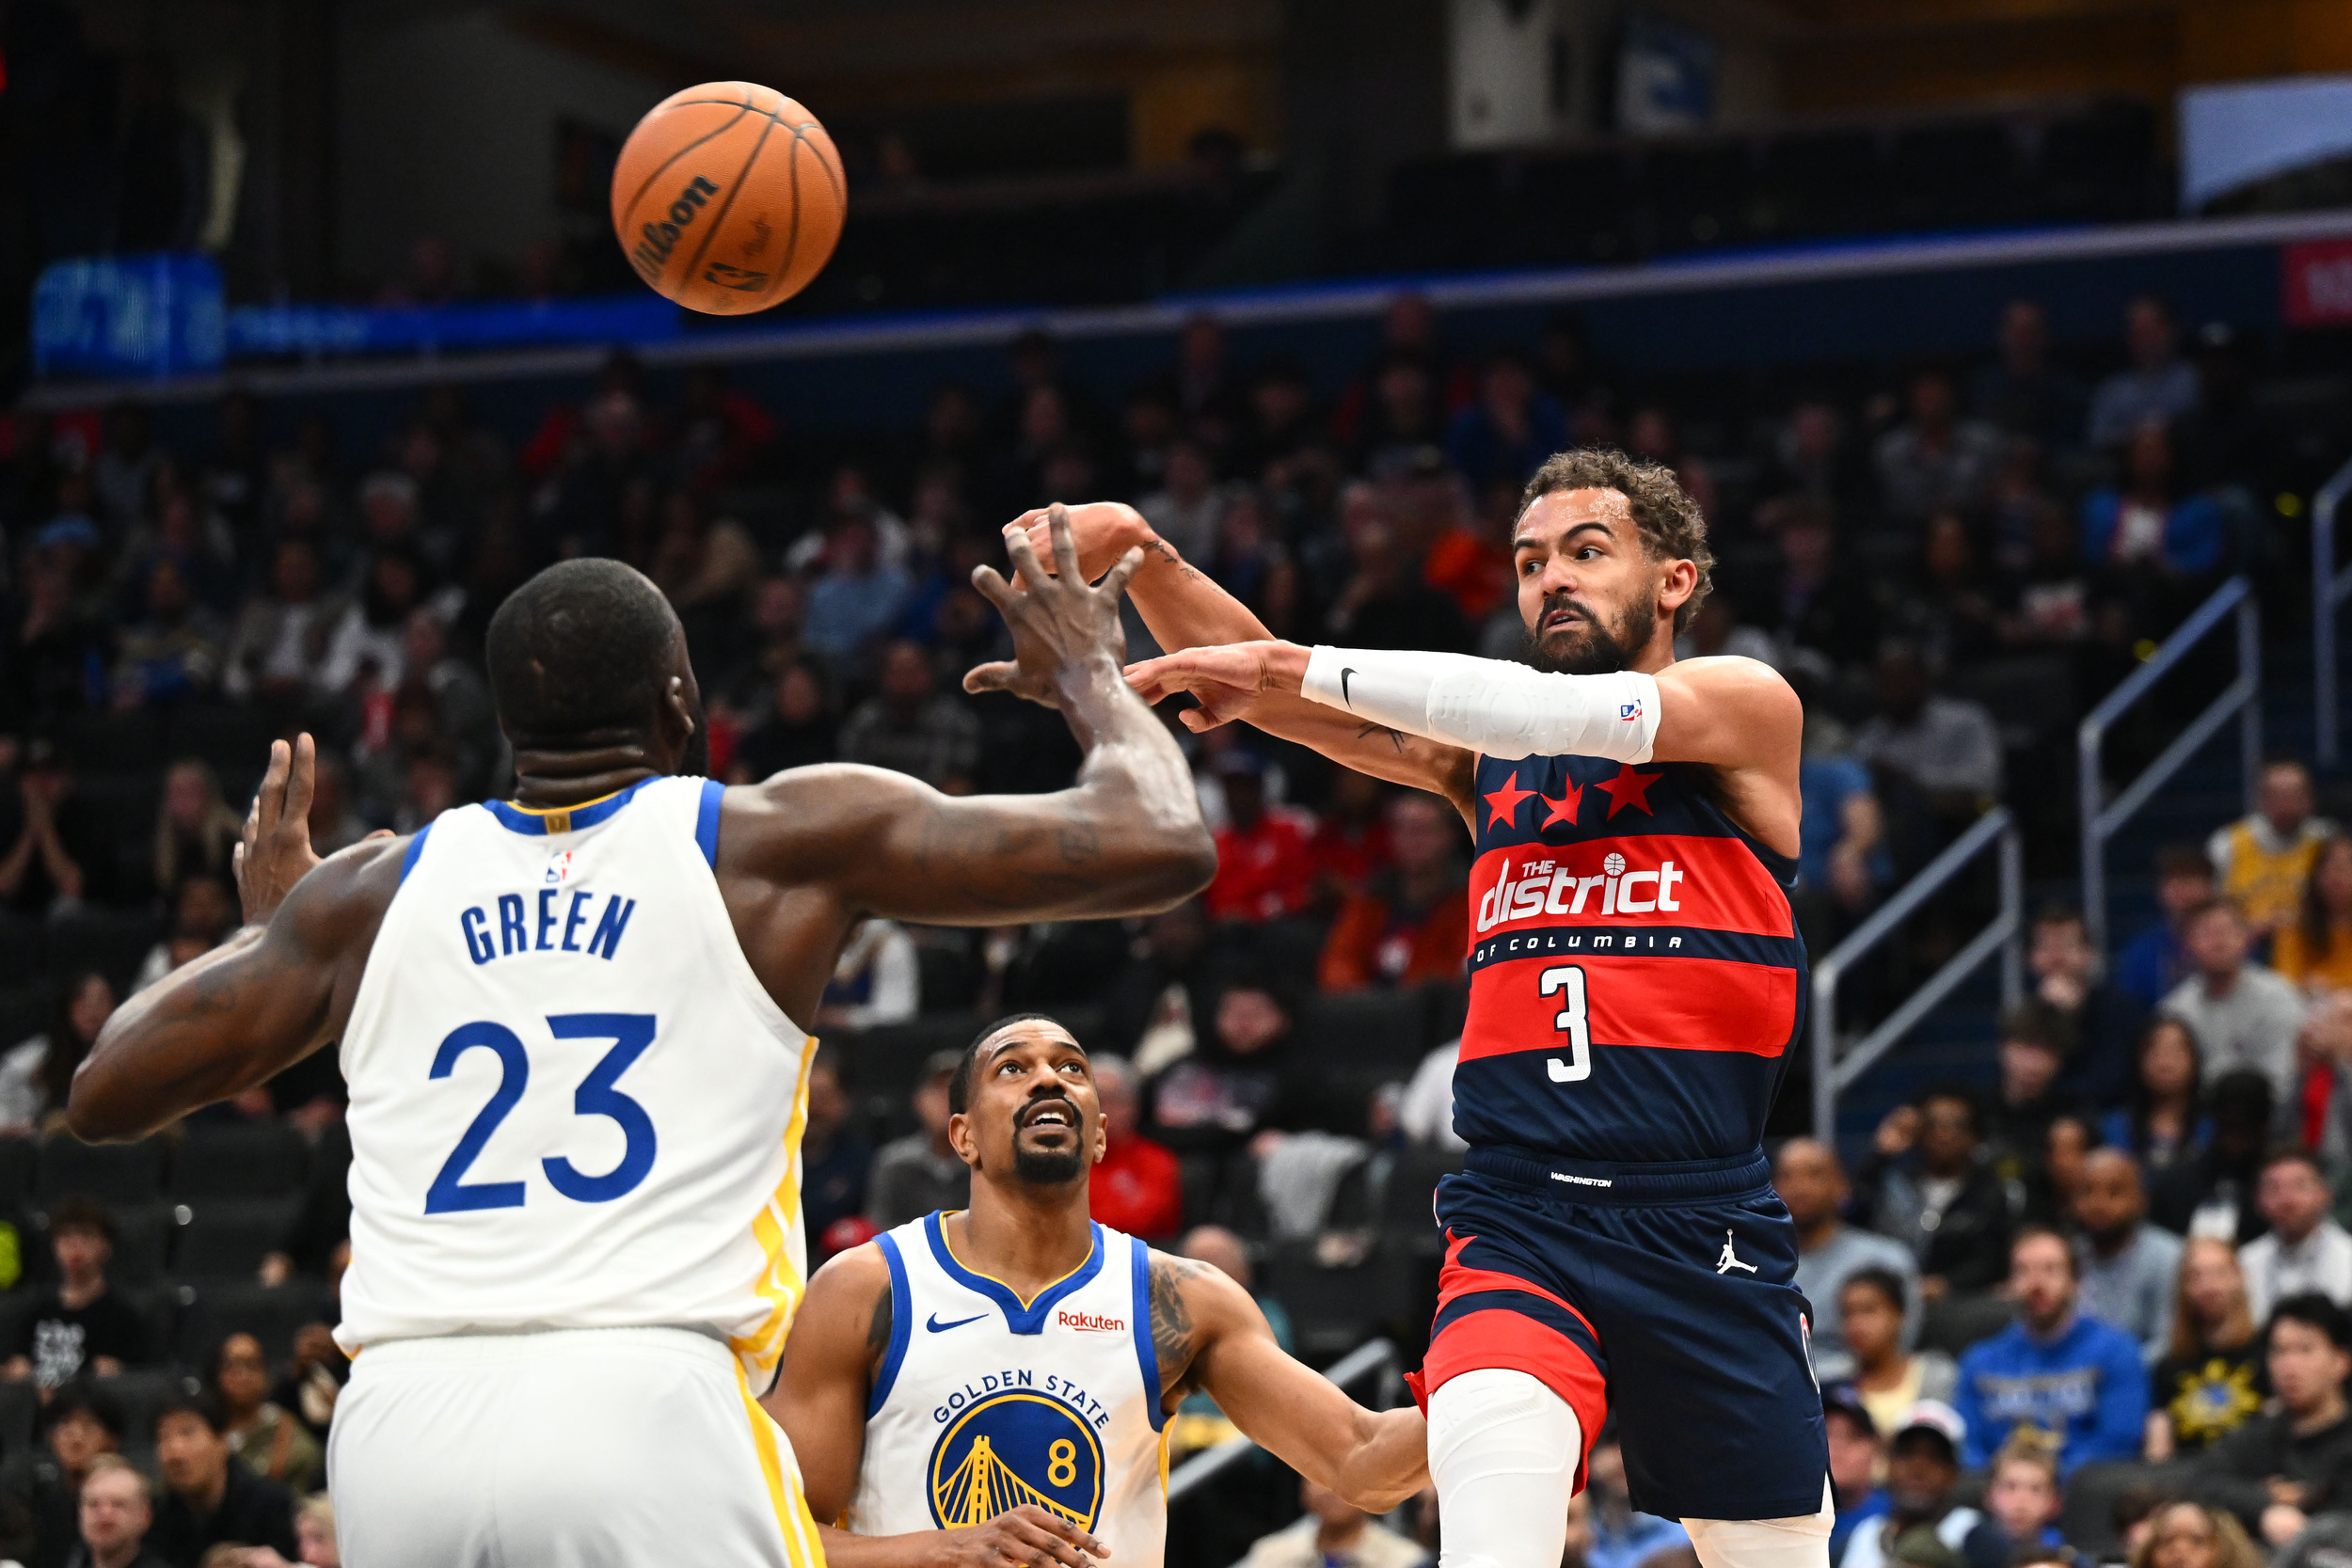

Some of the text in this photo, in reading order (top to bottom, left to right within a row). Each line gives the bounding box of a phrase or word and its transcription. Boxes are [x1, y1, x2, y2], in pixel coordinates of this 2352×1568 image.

[1476, 852, 1684, 933] district
[1522, 860, 1555, 878] THE
[460, 888, 637, 966] GREEN
[1476, 935, 1683, 963] OF COLUMBIA
[1539, 965, 1592, 1084] 3
[423, 1012, 658, 1215] 23
[1550, 1171, 1613, 1188] WASHINGTON
[1058, 1311, 1125, 1332] Rakuten
[933, 1369, 1110, 1430] GOLDEN STATE
[1047, 1438, 1077, 1488] 8
